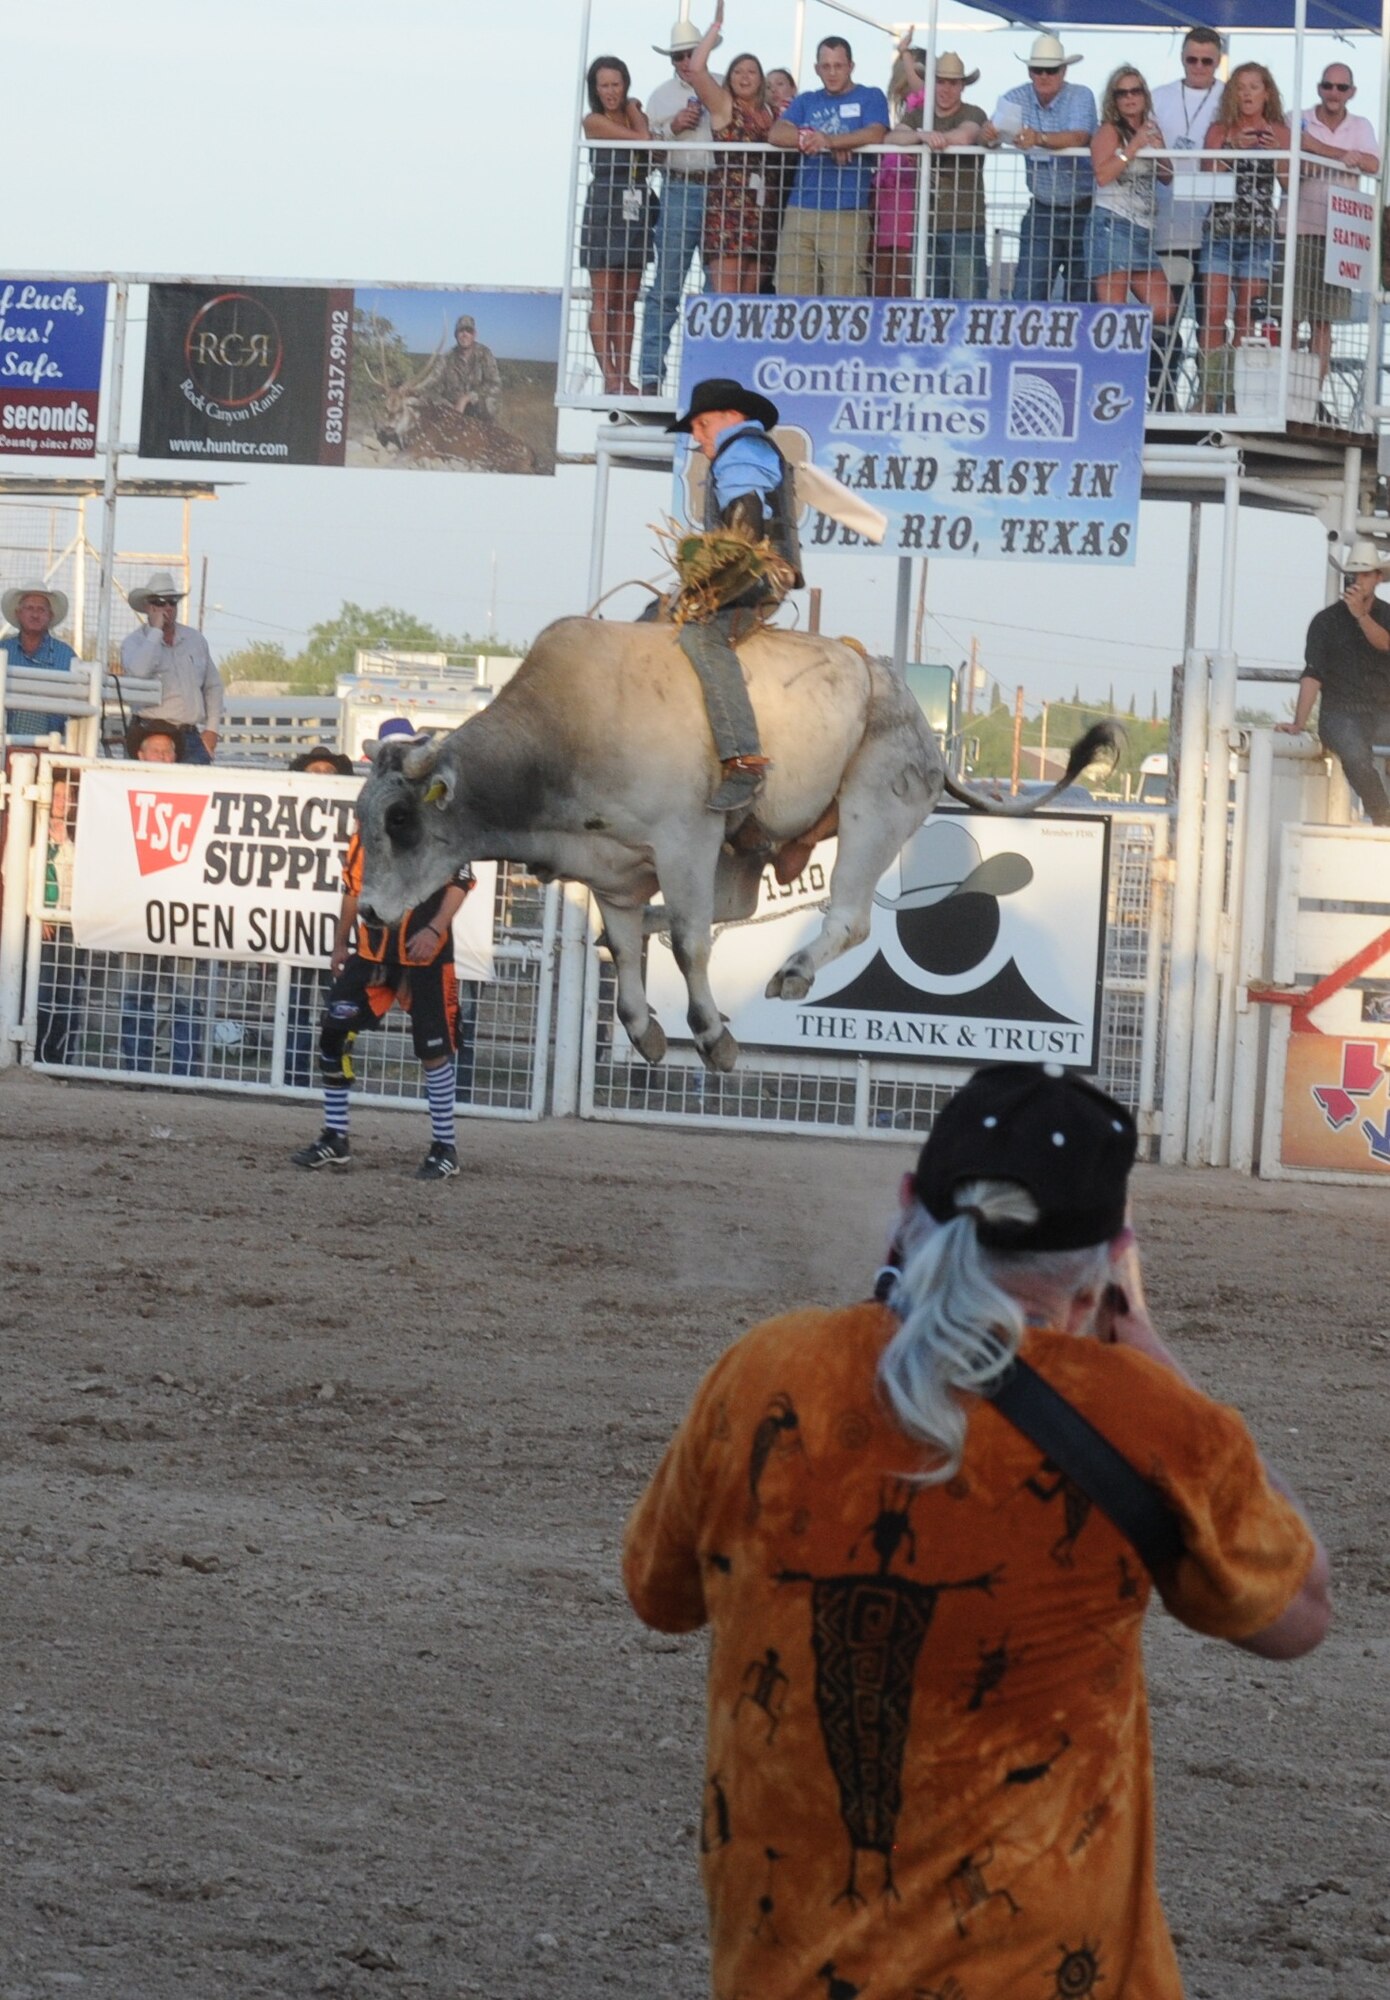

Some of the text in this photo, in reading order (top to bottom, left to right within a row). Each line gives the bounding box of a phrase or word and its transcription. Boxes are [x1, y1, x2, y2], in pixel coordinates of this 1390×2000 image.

[1331, 195, 1373, 222] RESERVED
[1333, 227, 1371, 252] SEATING
[1339, 260, 1361, 280] ONLY
[15, 285, 84, 316] Luck,
[686, 301, 1149, 351] COWBOYS FLY HIGH ON
[325, 309, 349, 444] 830.317.9942
[757, 360, 1132, 422] Continental &
[2, 401, 95, 433] seconds.
[180, 378, 285, 427] Rock Canyon Ranch
[836, 401, 986, 434] Airlines
[40, 438, 68, 450] since
[169, 436, 289, 457] www.huntrcr.com
[833, 453, 1118, 498] LAND EASY IN
[898, 513, 979, 557] RIO,
[1001, 518, 1131, 557] TEXAS
[136, 791, 358, 862] TSC TRACT
[203, 840, 350, 893] SUPPL
[146, 899, 234, 949] OPEN
[796, 1014, 1085, 1055] THE BANK & TRUST
